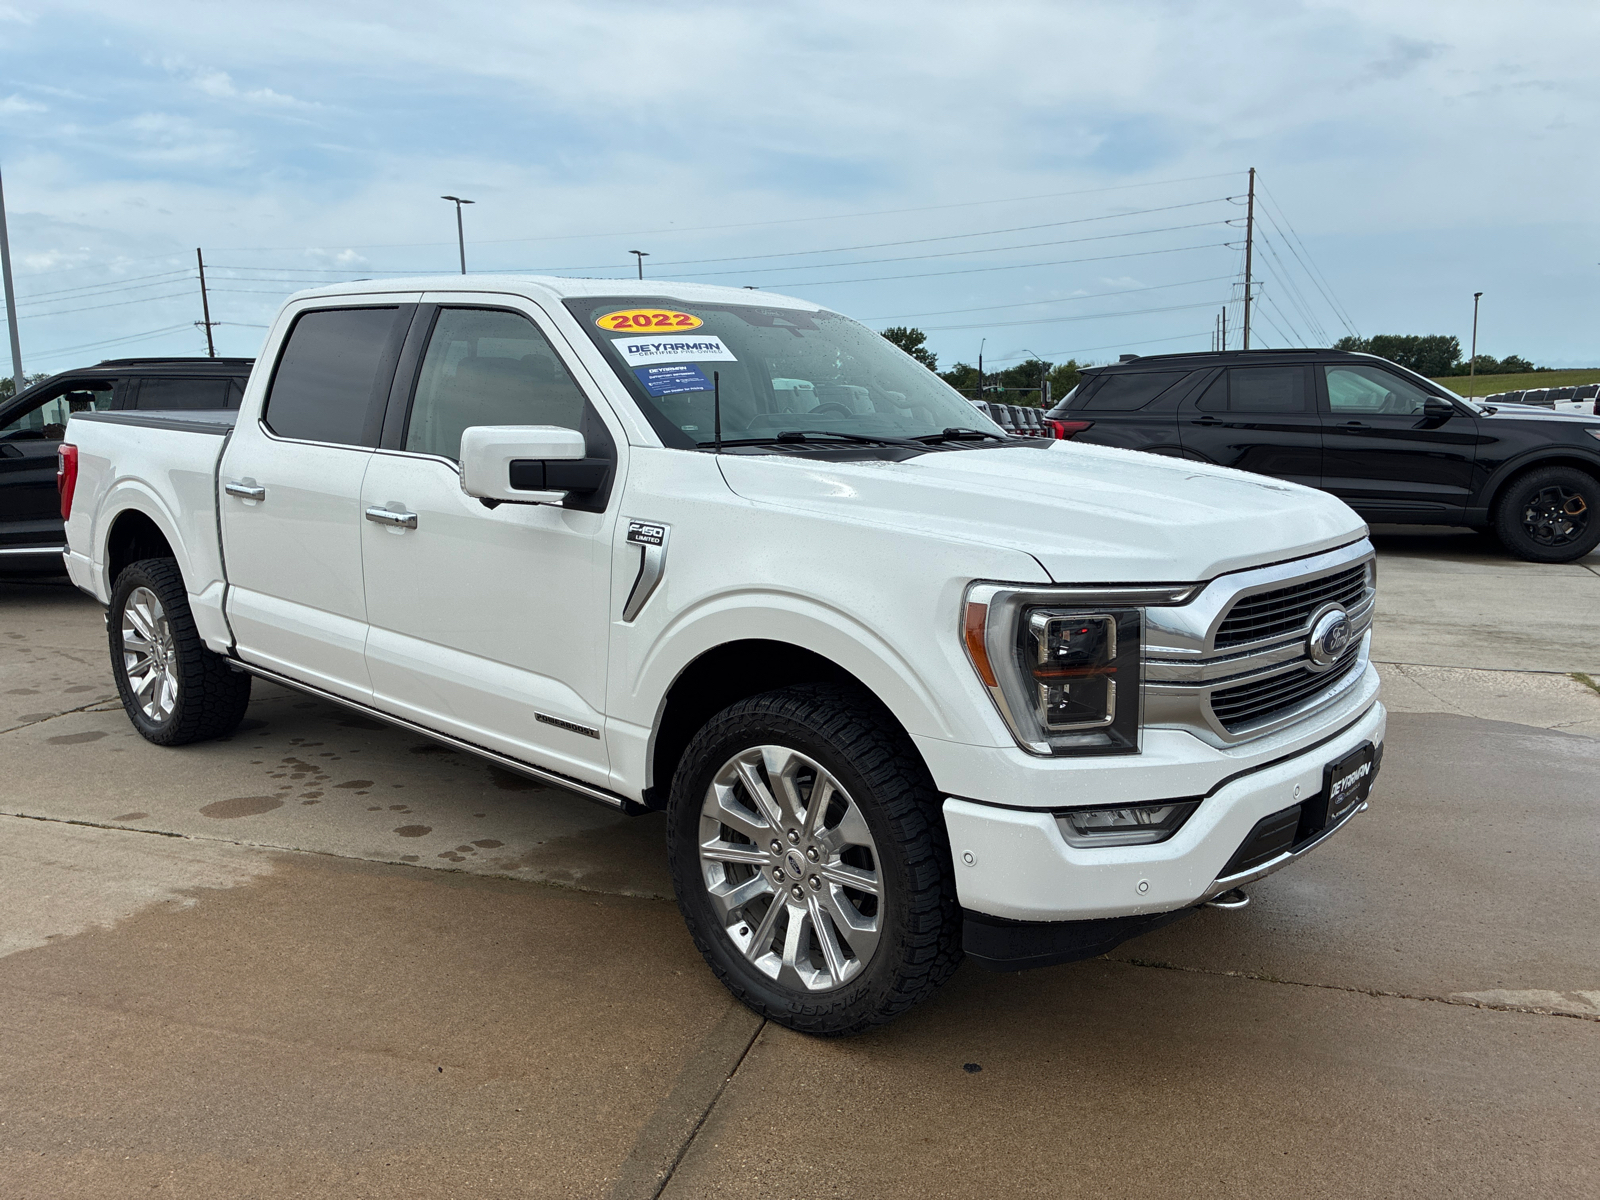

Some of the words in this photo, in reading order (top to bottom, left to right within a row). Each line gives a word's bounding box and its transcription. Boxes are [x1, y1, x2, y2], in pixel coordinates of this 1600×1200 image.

[610, 313, 695, 329] 2022
[627, 342, 721, 354] DEYARMAN
[648, 365, 687, 374] DEYARMAN
[629, 524, 664, 537] F-150
[635, 534, 660, 544] LIMITED
[1330, 625, 1349, 650] Ford
[1330, 761, 1372, 799] DEYARMAN
